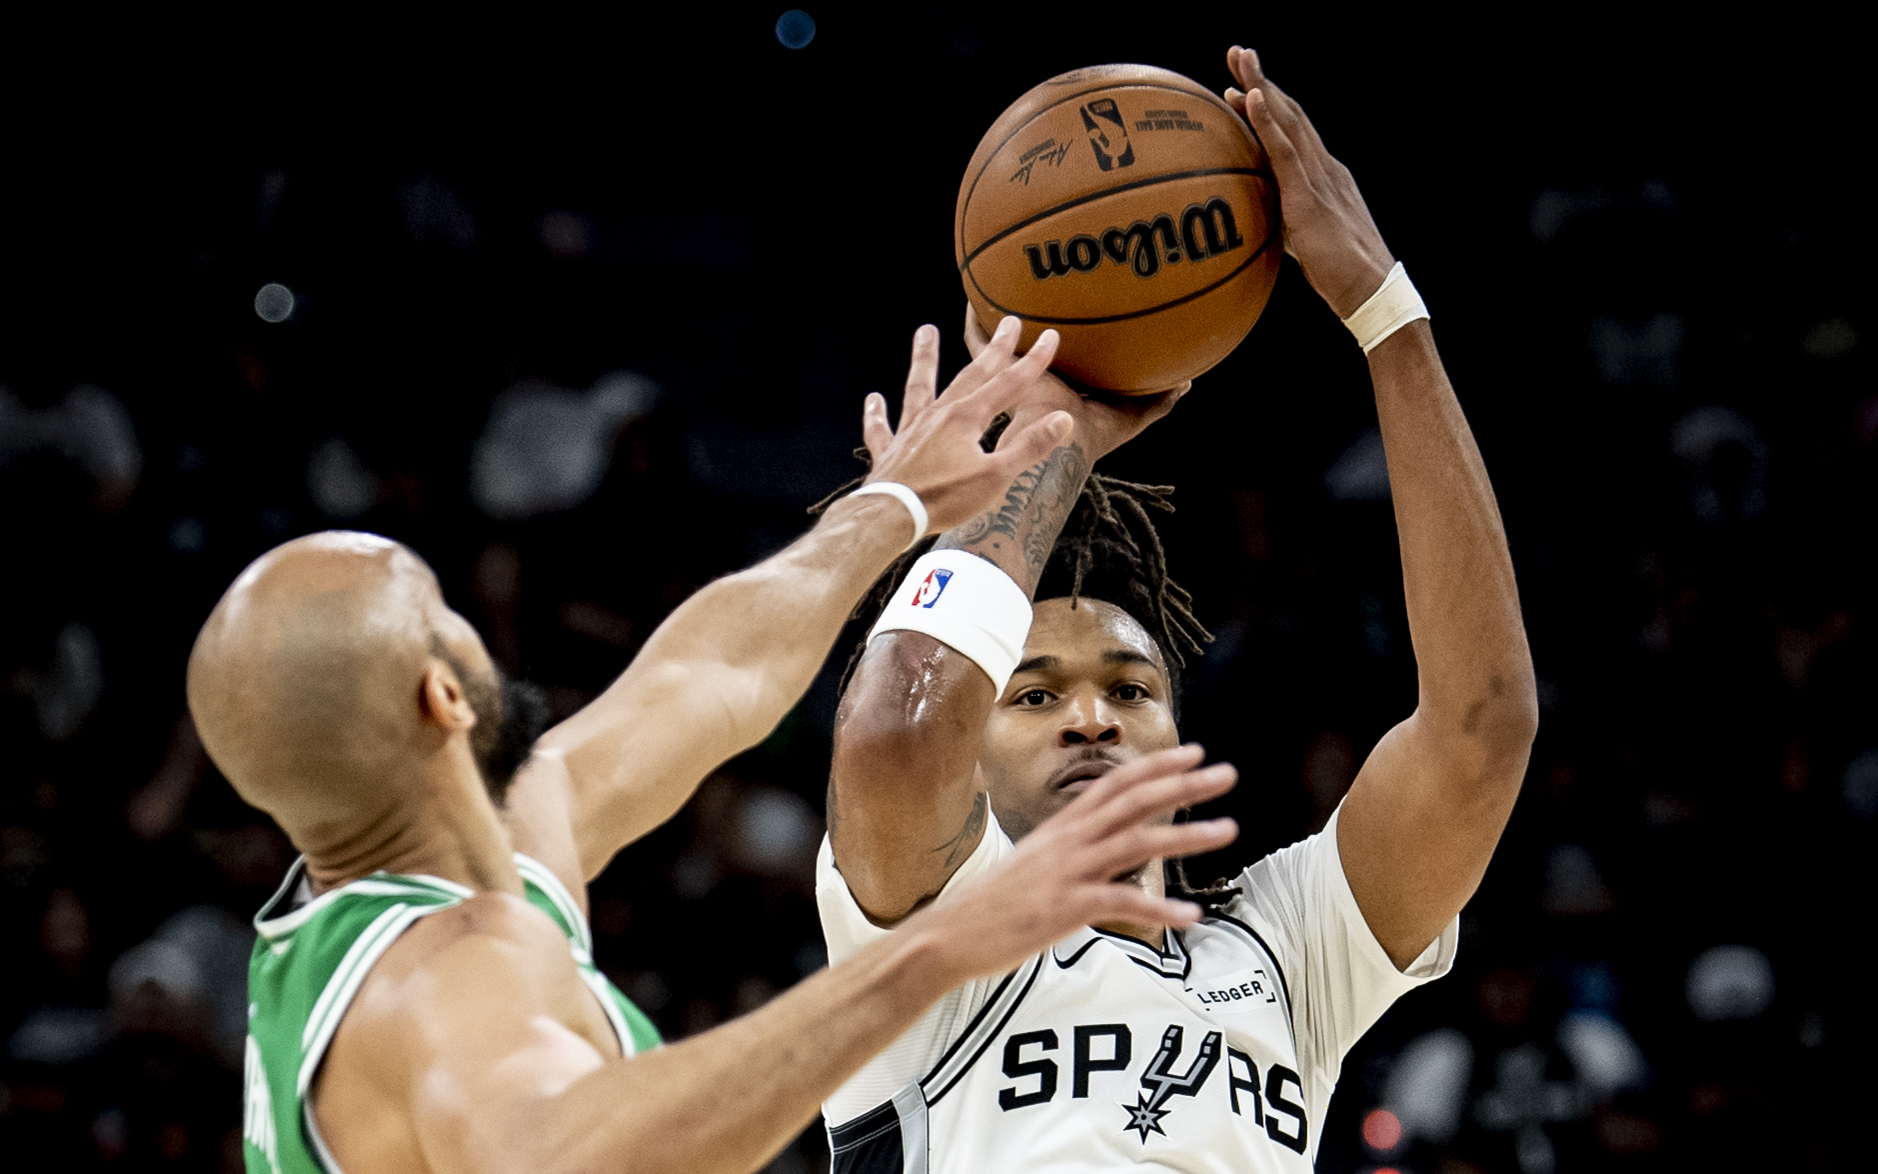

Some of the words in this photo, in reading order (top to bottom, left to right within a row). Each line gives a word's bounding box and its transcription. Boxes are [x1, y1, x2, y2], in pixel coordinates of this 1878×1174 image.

[1023, 196, 1243, 281] Wilson
[1197, 981, 1264, 1004] LEDGER
[998, 1023, 1308, 1156] SPURS
